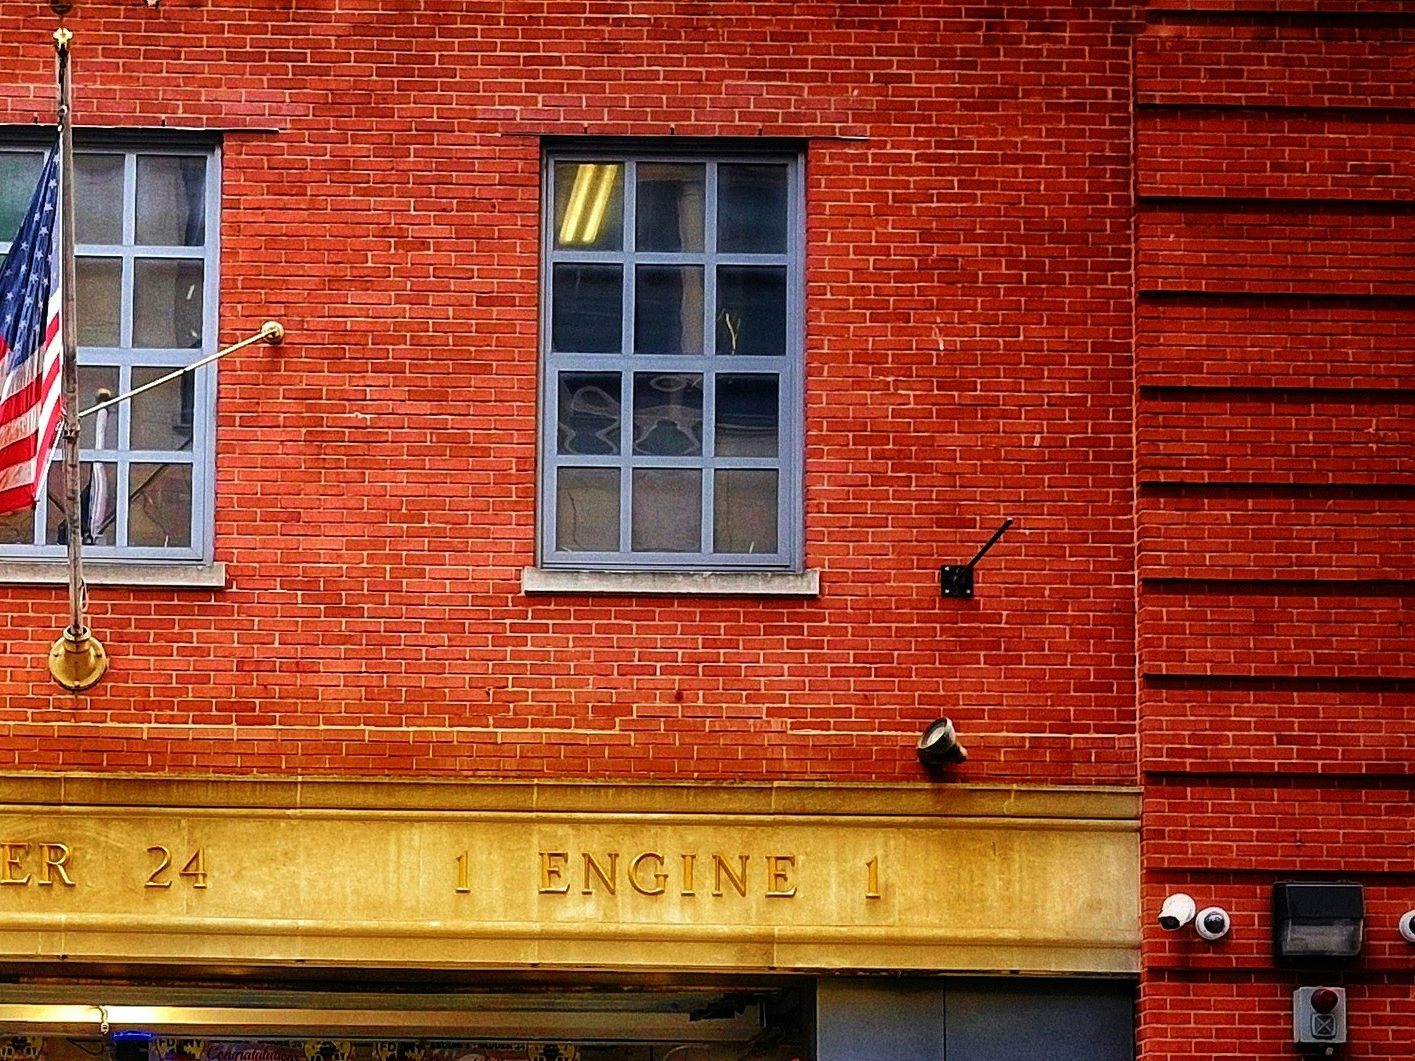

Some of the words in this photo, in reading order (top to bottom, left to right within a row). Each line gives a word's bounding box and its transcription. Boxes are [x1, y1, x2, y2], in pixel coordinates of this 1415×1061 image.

[145, 845, 208, 889] 24
[454, 849, 472, 893] 1
[538, 850, 798, 898] ENGINE
[864, 855, 882, 899] 1
